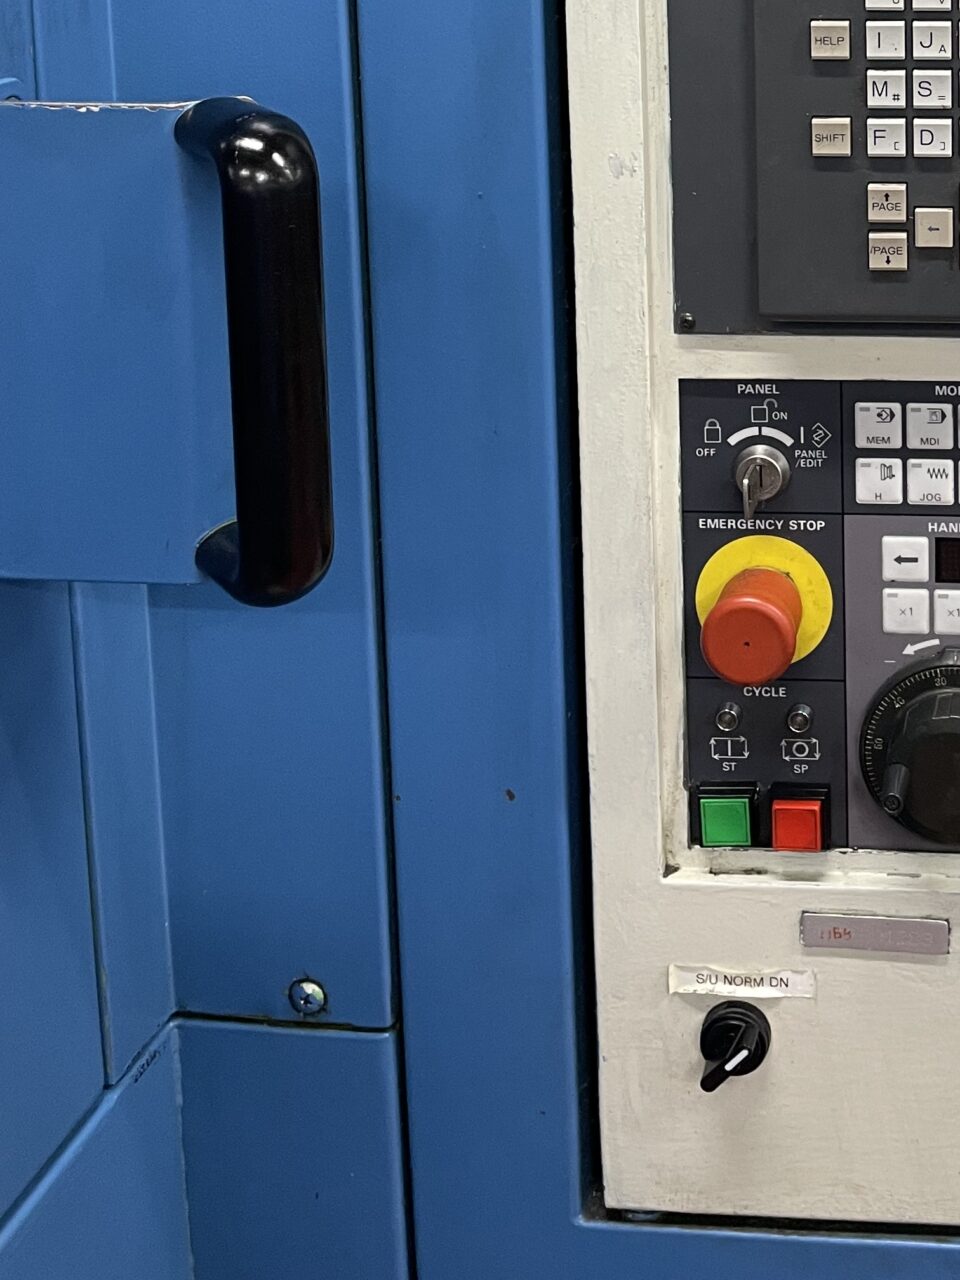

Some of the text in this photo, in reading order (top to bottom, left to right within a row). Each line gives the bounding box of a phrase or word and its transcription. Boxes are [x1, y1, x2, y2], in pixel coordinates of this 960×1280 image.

[815, 37, 844, 46] HELP
[815, 133, 846, 143] SHIFT
[872, 202, 901, 211] PAGE
[737, 384, 780, 394] PANEL
[772, 412, 788, 420] ON
[866, 436, 891, 445] MEM
[920, 437, 939, 446] MDI
[696, 448, 716, 456] OFF
[795, 450, 827, 458] PANEL
[795, 459, 823, 468] /EDIT
[920, 494, 941, 502] JOG
[699, 519, 825, 530] EMERGENCY STOP
[743, 687, 787, 697] CYCLE
[696, 974, 789, 988] S/U NORM DN
